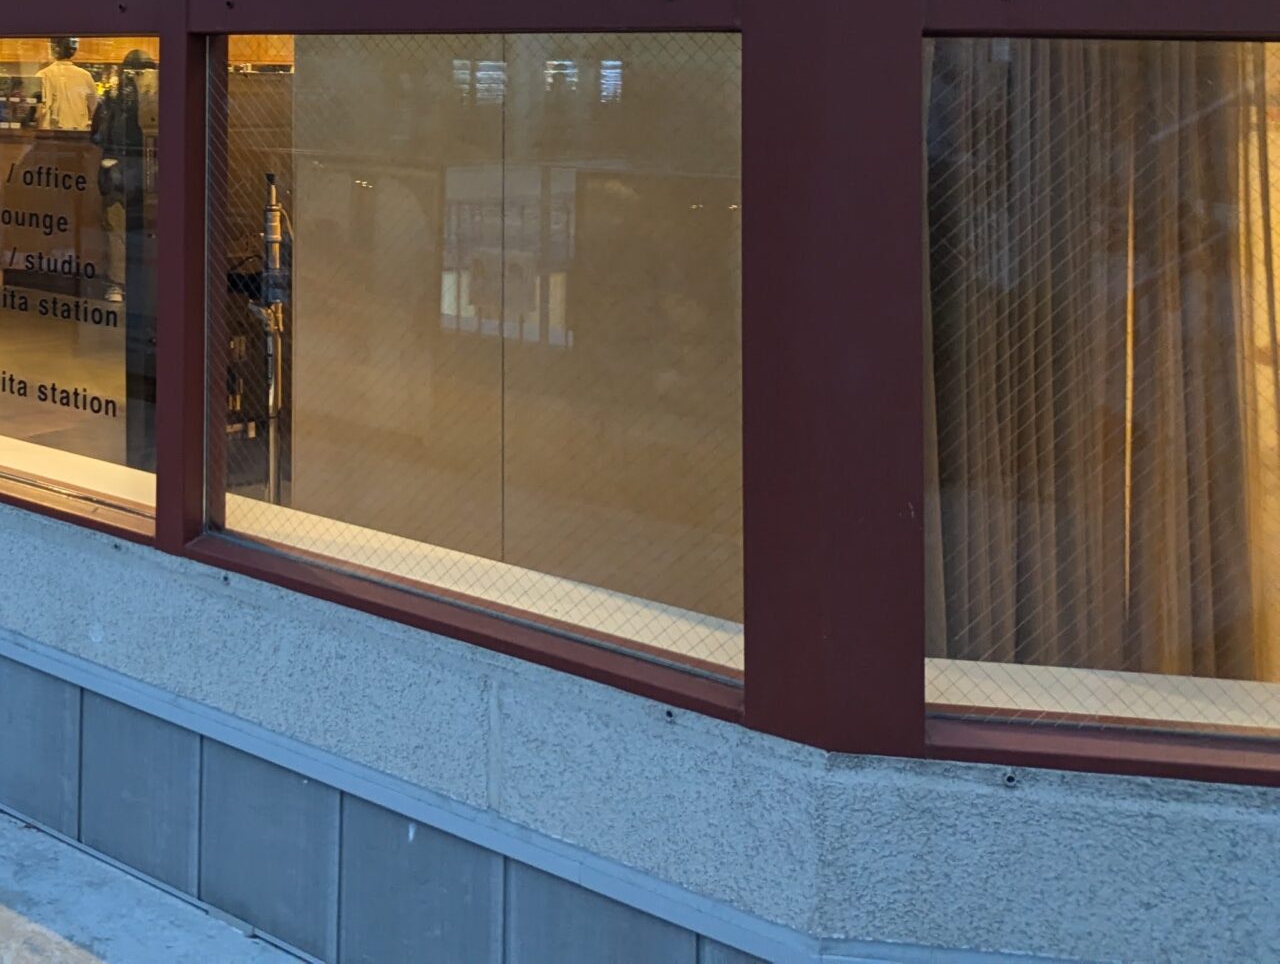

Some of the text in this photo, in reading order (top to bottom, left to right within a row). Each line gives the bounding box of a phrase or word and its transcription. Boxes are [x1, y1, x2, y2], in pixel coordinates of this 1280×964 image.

[23, 166, 87, 192] office
[25, 252, 96, 280] studio
[38, 297, 118, 328] station
[38, 383, 118, 418] station
